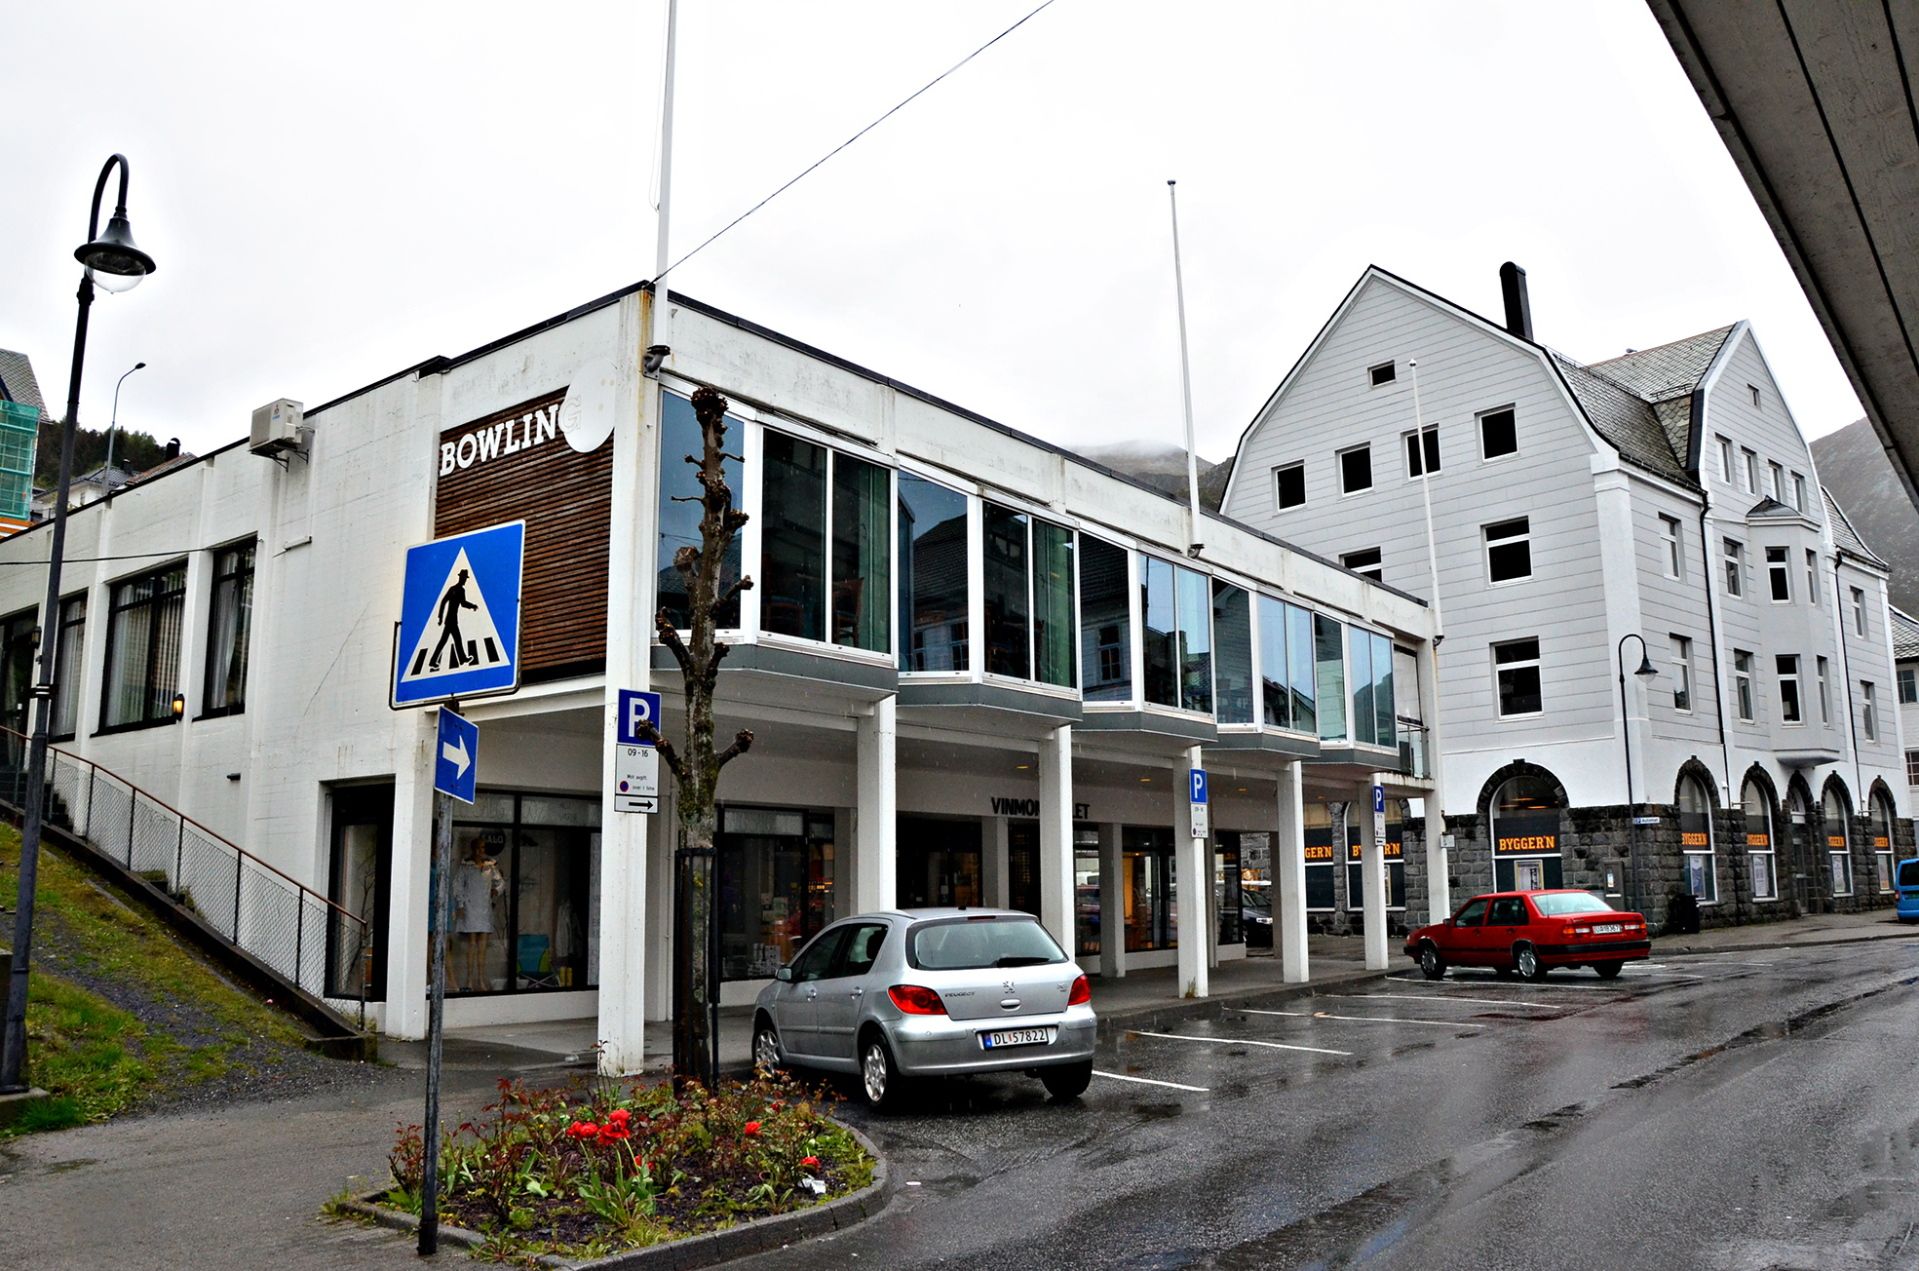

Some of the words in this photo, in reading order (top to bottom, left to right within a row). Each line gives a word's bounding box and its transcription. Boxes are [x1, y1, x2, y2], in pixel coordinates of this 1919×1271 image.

[439, 394, 582, 477] BOWLING
[628, 697, 651, 738] P
[1194, 773, 1204, 799] P
[1375, 788, 1382, 810] P
[1304, 846, 1332, 859] GER'N
[1499, 835, 1555, 851] BYGGER'N
